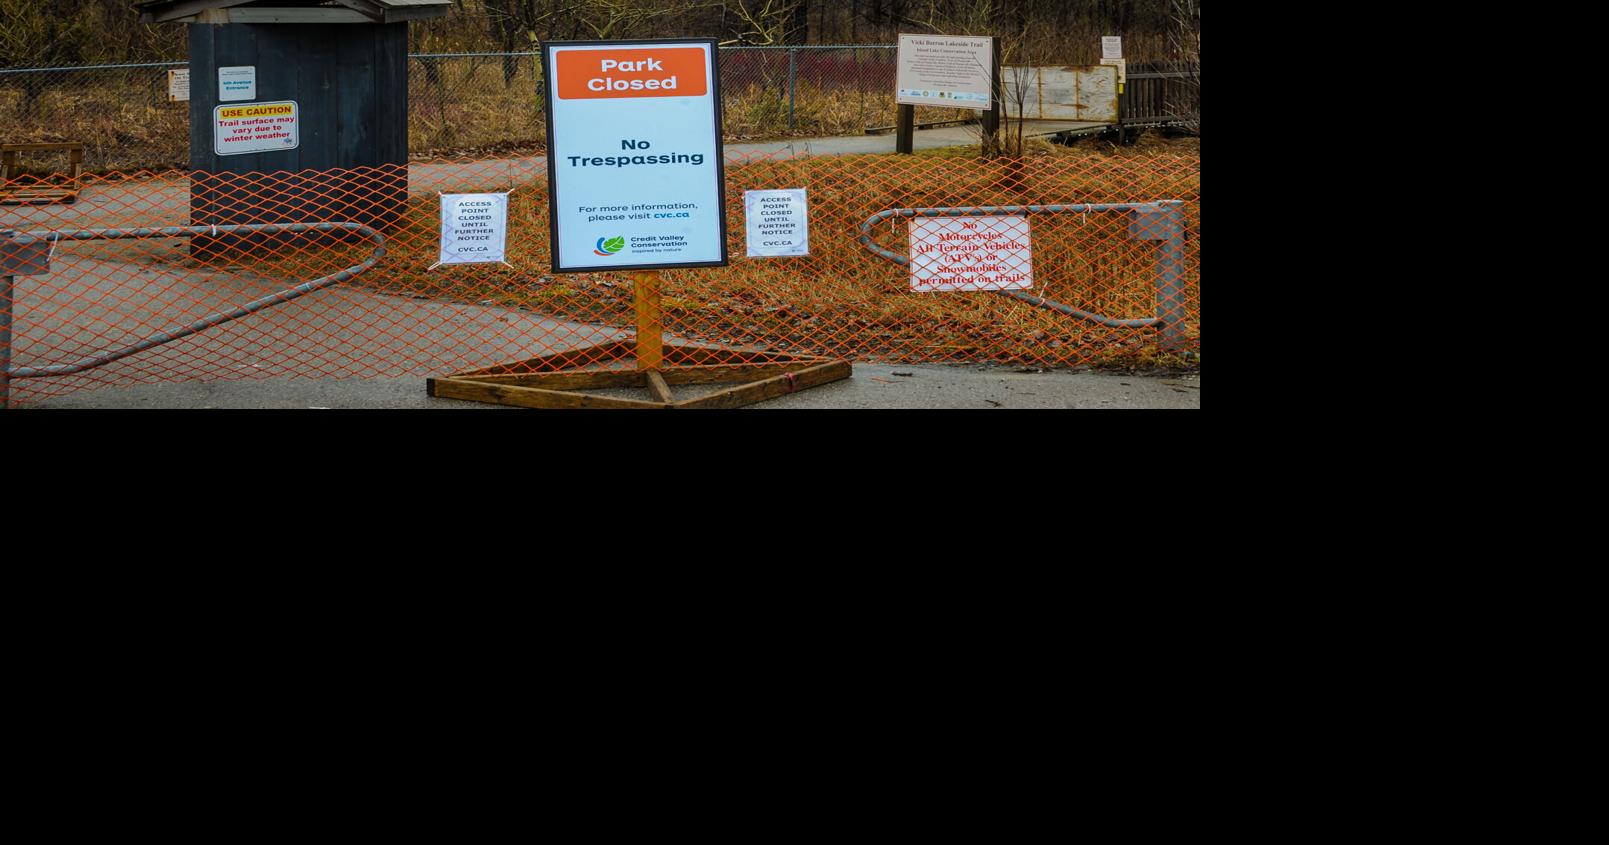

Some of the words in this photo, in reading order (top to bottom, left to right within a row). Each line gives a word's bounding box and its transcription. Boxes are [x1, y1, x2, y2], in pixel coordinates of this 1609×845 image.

[601, 58, 664, 72] Park
[587, 76, 677, 91] Closed
[246, 106, 292, 116] CAUTION
[241, 118, 274, 126] surface
[277, 116, 295, 124] may
[224, 134, 252, 142] winter
[255, 132, 290, 140] weather
[621, 139, 651, 150] No
[568, 152, 704, 168] Trespassing
[632, 202, 698, 210] information,
[588, 214, 625, 222] please
[654, 211, 690, 219] cvc.ca
[940, 232, 1002, 242] Motorcycles
[938, 243, 980, 252] Terrain
[936, 262, 1007, 273] Snowmobiles
[920, 276, 974, 286] permitted
[995, 274, 1025, 282] trails
